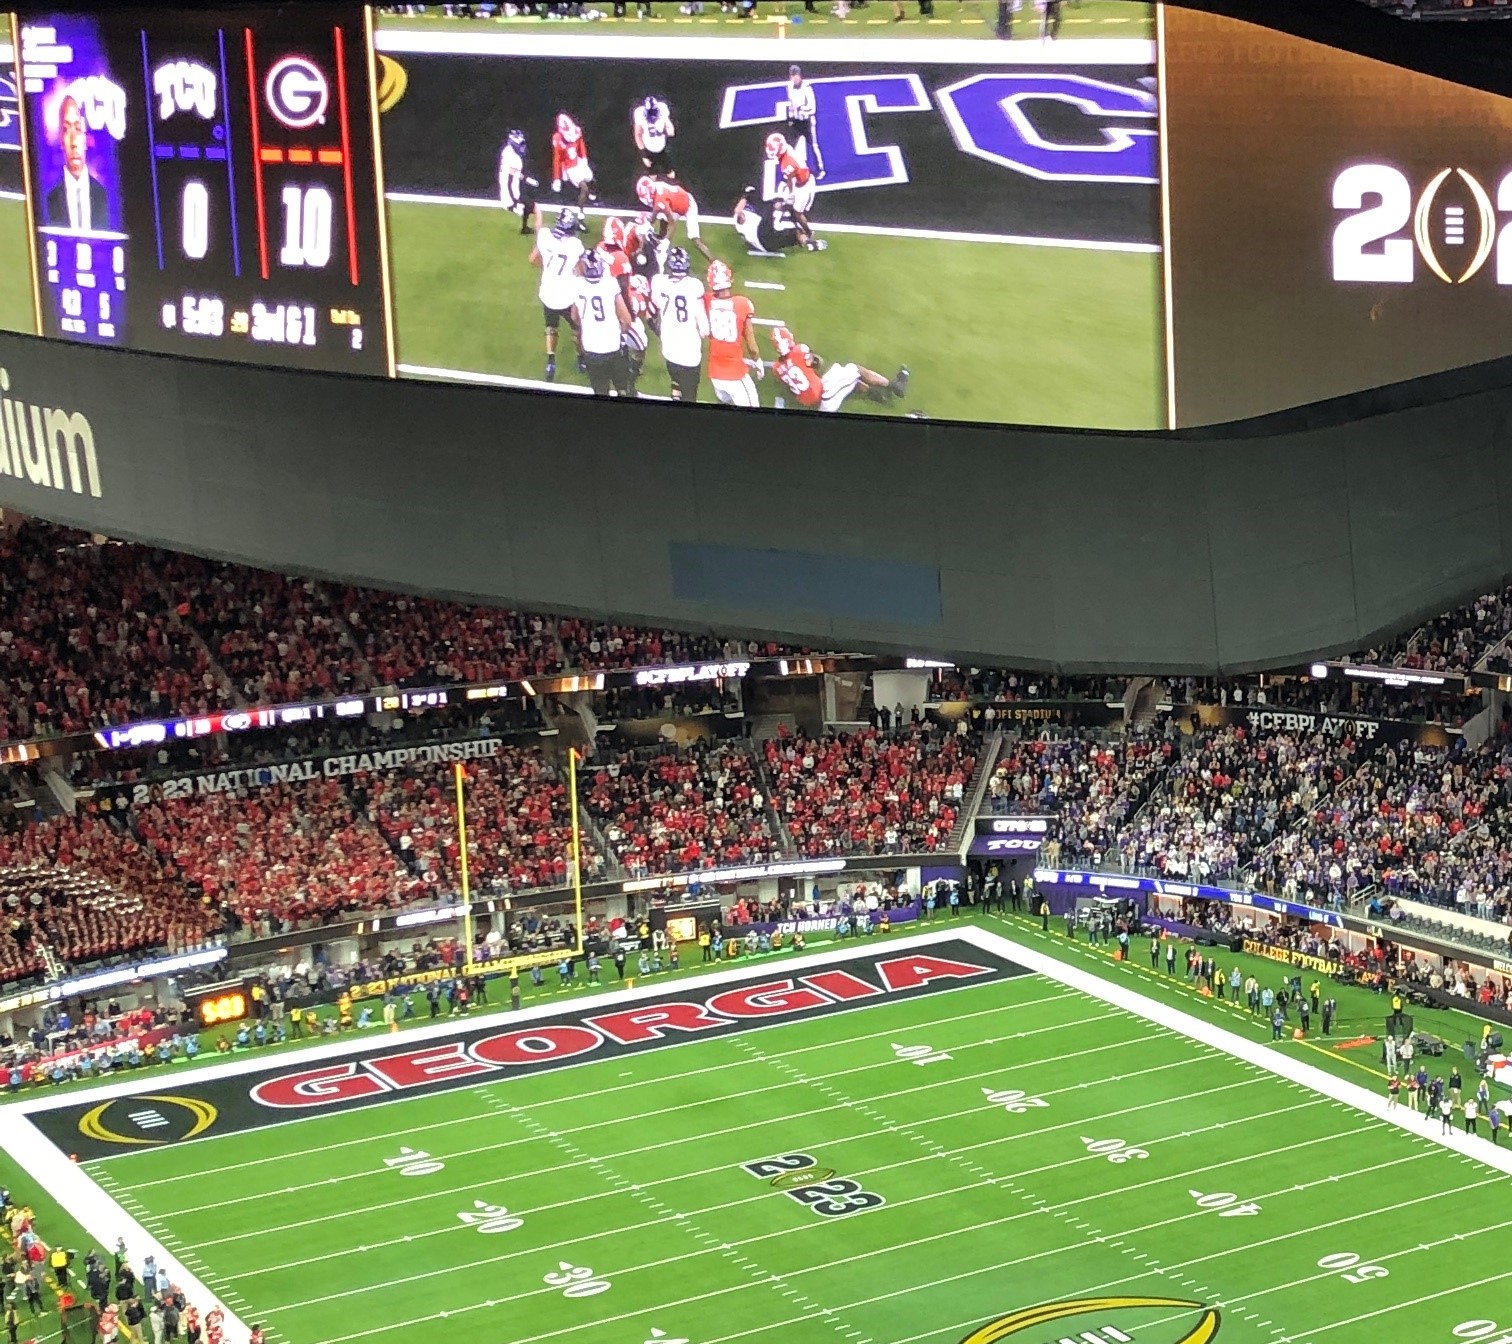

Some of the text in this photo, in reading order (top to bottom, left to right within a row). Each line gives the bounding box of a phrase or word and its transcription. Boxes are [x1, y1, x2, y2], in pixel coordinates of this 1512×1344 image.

[281, 188, 333, 267] 10
[324, 738, 502, 778] CHAMPIONSHIP
[987, 839, 1041, 851] TCU
[1243, 940, 1344, 973] COLLEGE FOOTBALL
[250, 954, 997, 1109] GEORGIA
[989, 1089, 1049, 1114] 20
[383, 1153, 445, 1177] 10
[1087, 1138, 1149, 1164] 30
[457, 1205, 524, 1234] 20
[1196, 1192, 1263, 1218] 40
[543, 1265, 611, 1298] 30
[1317, 1252, 1391, 1283] 50
